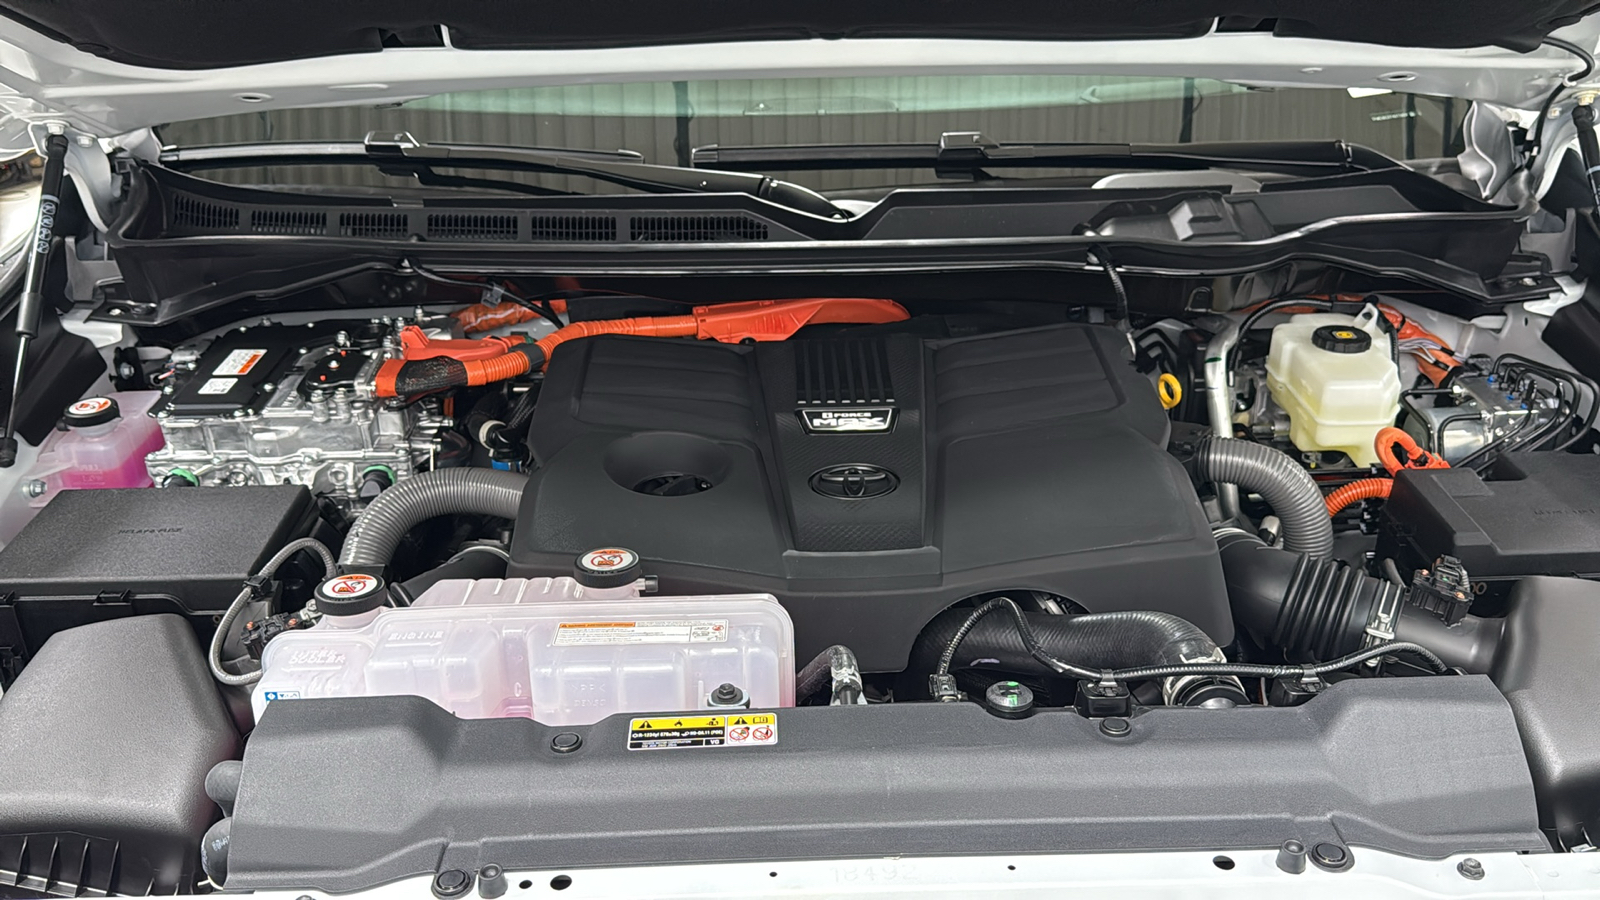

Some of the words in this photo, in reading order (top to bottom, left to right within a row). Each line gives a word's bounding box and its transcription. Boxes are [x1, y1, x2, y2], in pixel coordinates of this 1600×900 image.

[813, 418, 885, 427] MAX
[387, 631, 444, 641] ENGINE
[573, 699, 607, 707] DENSO
